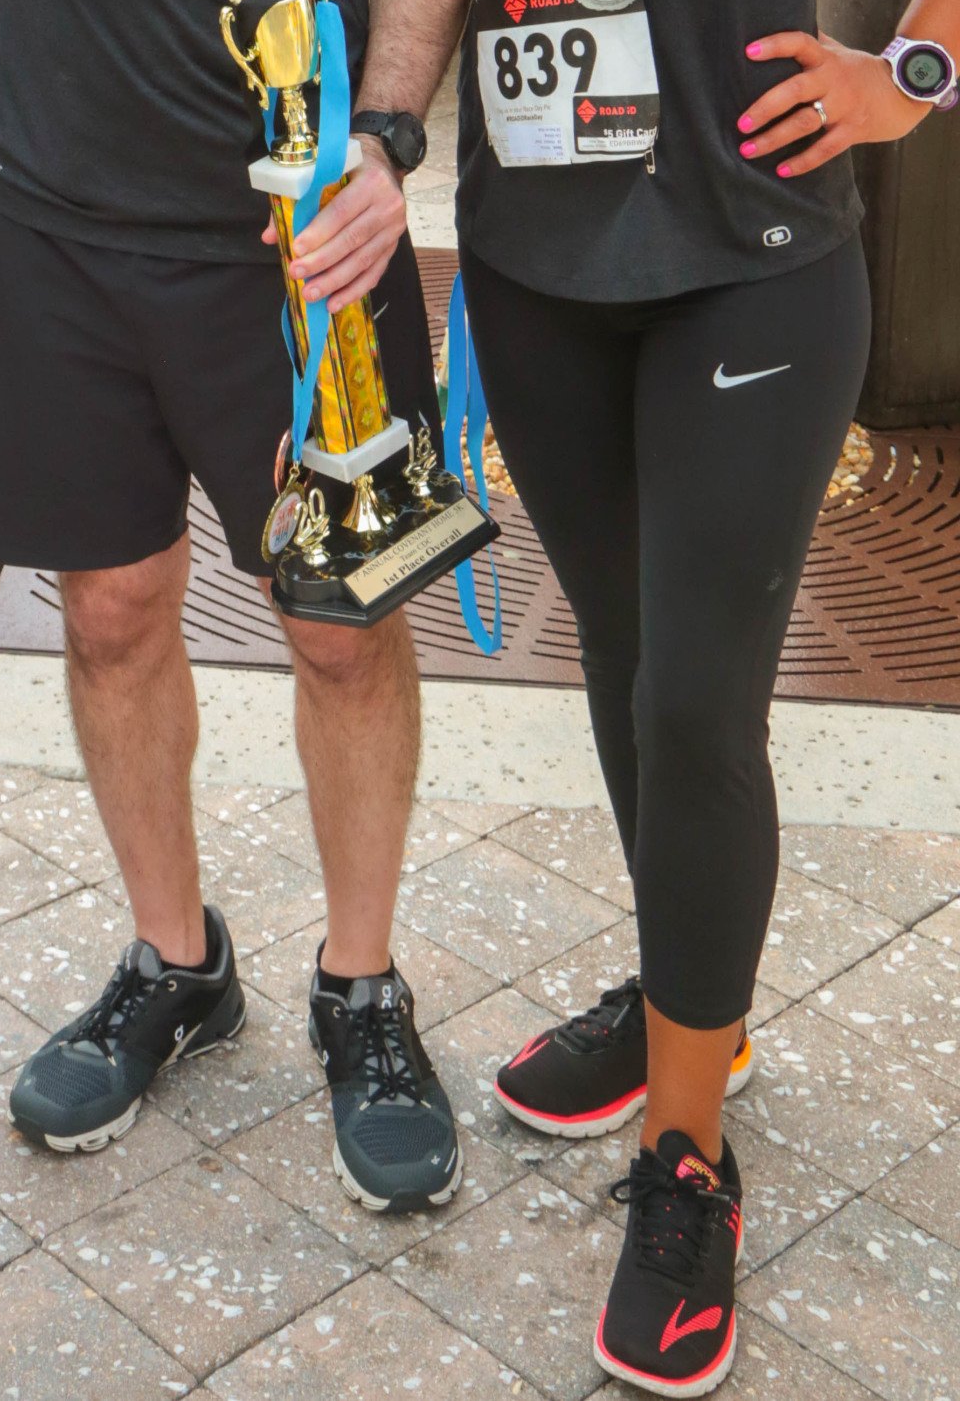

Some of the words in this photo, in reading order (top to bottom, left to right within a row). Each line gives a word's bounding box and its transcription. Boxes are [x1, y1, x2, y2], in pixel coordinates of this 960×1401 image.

[494, 27, 598, 99] 839
[599, 106, 625, 116] ROAD
[615, 128, 635, 138] Gift
[362, 554, 392, 576] ANNUAL
[392, 525, 433, 555] COVENANT
[433, 510, 455, 529] HOME
[383, 572, 400, 586] 1st
[398, 555, 427, 576] Place
[425, 528, 462, 556] Overall
[416, 536, 432, 550] CDC
[683, 1157, 720, 1190] BROOK
